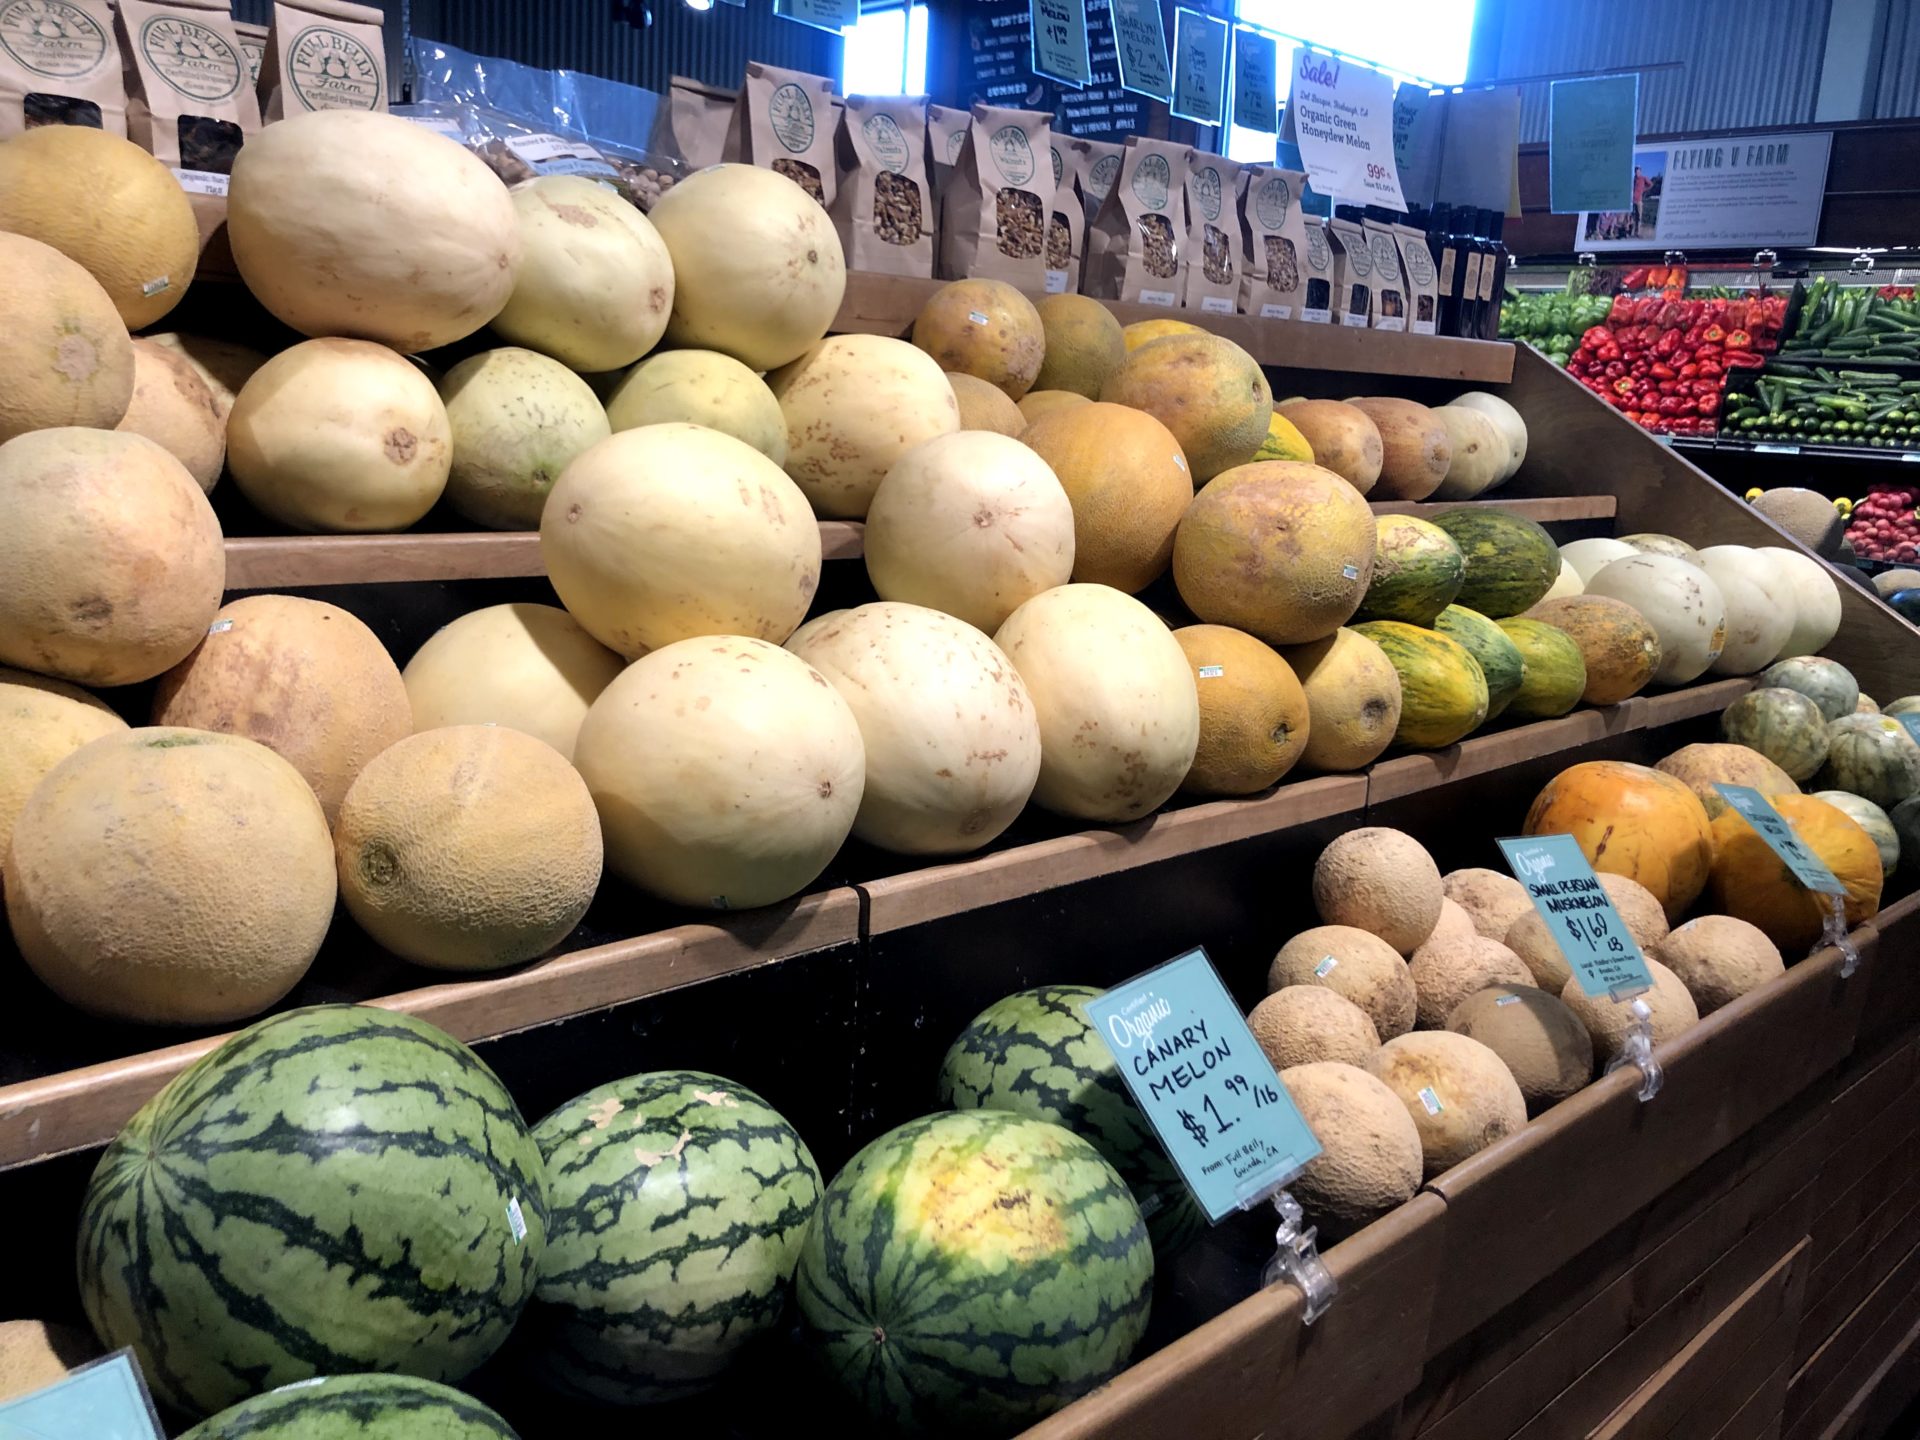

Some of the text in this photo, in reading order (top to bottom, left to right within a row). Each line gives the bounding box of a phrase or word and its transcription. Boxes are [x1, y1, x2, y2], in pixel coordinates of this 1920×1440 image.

[150, 22, 179, 50] FULL
[179, 23, 232, 59] BELLY
[1122, 29, 1157, 47] MELON
[296, 34, 375, 79] FULL BELLY
[1300, 54, 1340, 89] Sale!
[311, 76, 366, 94] Farm
[1091, 72, 1115, 84] ALL
[1300, 105, 1357, 132] Organic Green
[1301, 121, 1371, 151] Honeydew Melon
[1672, 143, 1791, 171] FLYING V FARM
[1516, 848, 1556, 885] Organic
[1529, 876, 1600, 898] SMALL PERSIAN
[1108, 992, 1171, 1052] Organic
[1133, 1018, 1209, 1076] CANARY
[1149, 1037, 1232, 1101] MELON
[1265, 1145, 1279, 1157] CA
